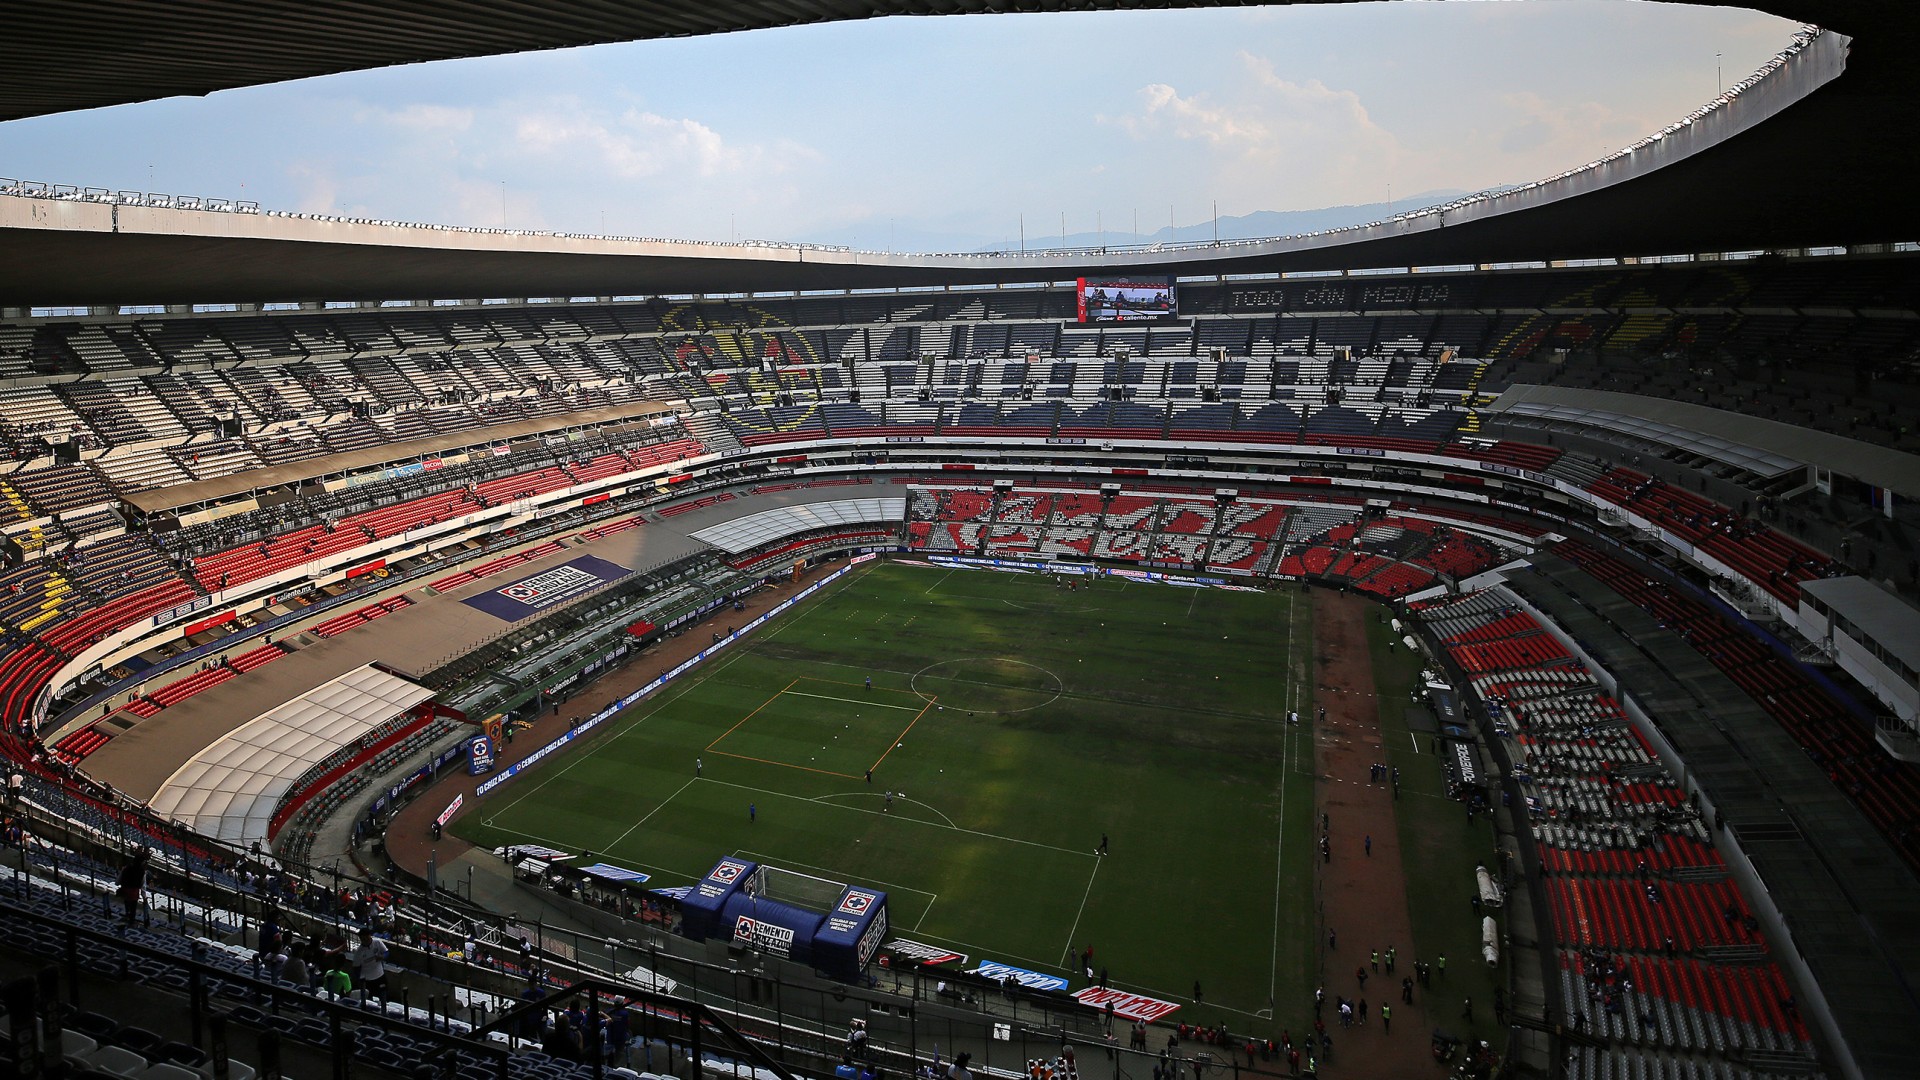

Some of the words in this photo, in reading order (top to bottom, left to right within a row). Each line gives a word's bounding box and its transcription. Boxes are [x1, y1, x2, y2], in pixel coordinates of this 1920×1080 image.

[1233, 290, 1284, 306] TODO
[1364, 285, 1449, 303] MEDIDA
[424, 460, 441, 469] RICOH
[522, 566, 574, 588] CEMENTO
[536, 574, 562, 594] CRUZ
[558, 570, 588, 586] AZUL
[1258, 571, 1296, 581] caente.mx
[276, 584, 311, 602] caliente.mx
[80, 668, 101, 685] Corona
[55, 682, 78, 700] Corona
[521, 748, 544, 769] CEMENTO
[544, 741, 556, 754] CRUZ
[557, 733, 569, 747] AZUL
[1454, 744, 1476, 784] POWERADE
[484, 776, 497, 792] CRUZ
[498, 767, 512, 783] AZUL
[754, 922, 790, 940] CEMENTO
